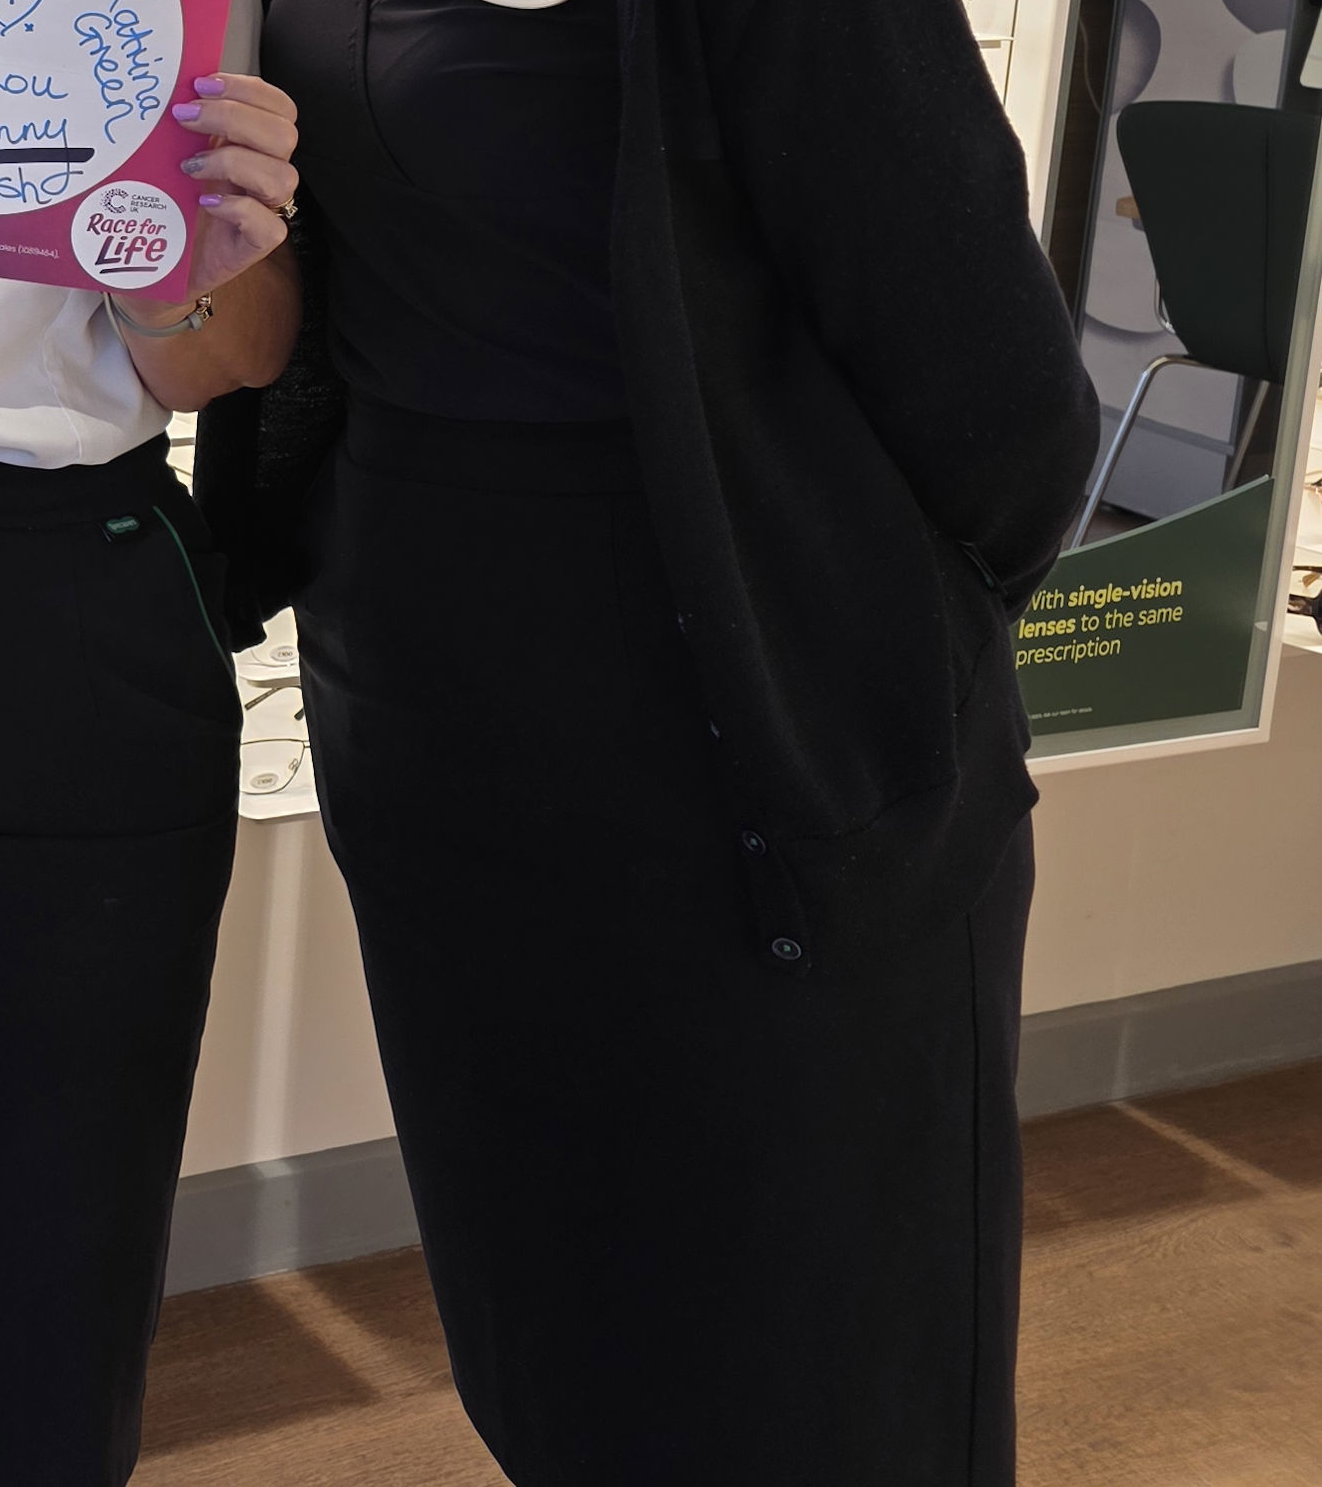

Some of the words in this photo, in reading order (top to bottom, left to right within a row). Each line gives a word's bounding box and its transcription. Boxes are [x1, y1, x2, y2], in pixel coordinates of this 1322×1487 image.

[74, 13, 134, 144] Green
[130, 200, 167, 210] RESEARCH
[131, 194, 160, 203] CANCER
[87, 213, 137, 235] Race
[139, 218, 167, 235] for
[95, 235, 168, 266] Life
[1068, 577, 1183, 609] single-vision
[1018, 617, 1076, 640] lenses
[1081, 614, 1100, 632] to
[1105, 608, 1134, 630] the
[1138, 606, 1183, 626] same
[1015, 636, 1121, 670] prescription
